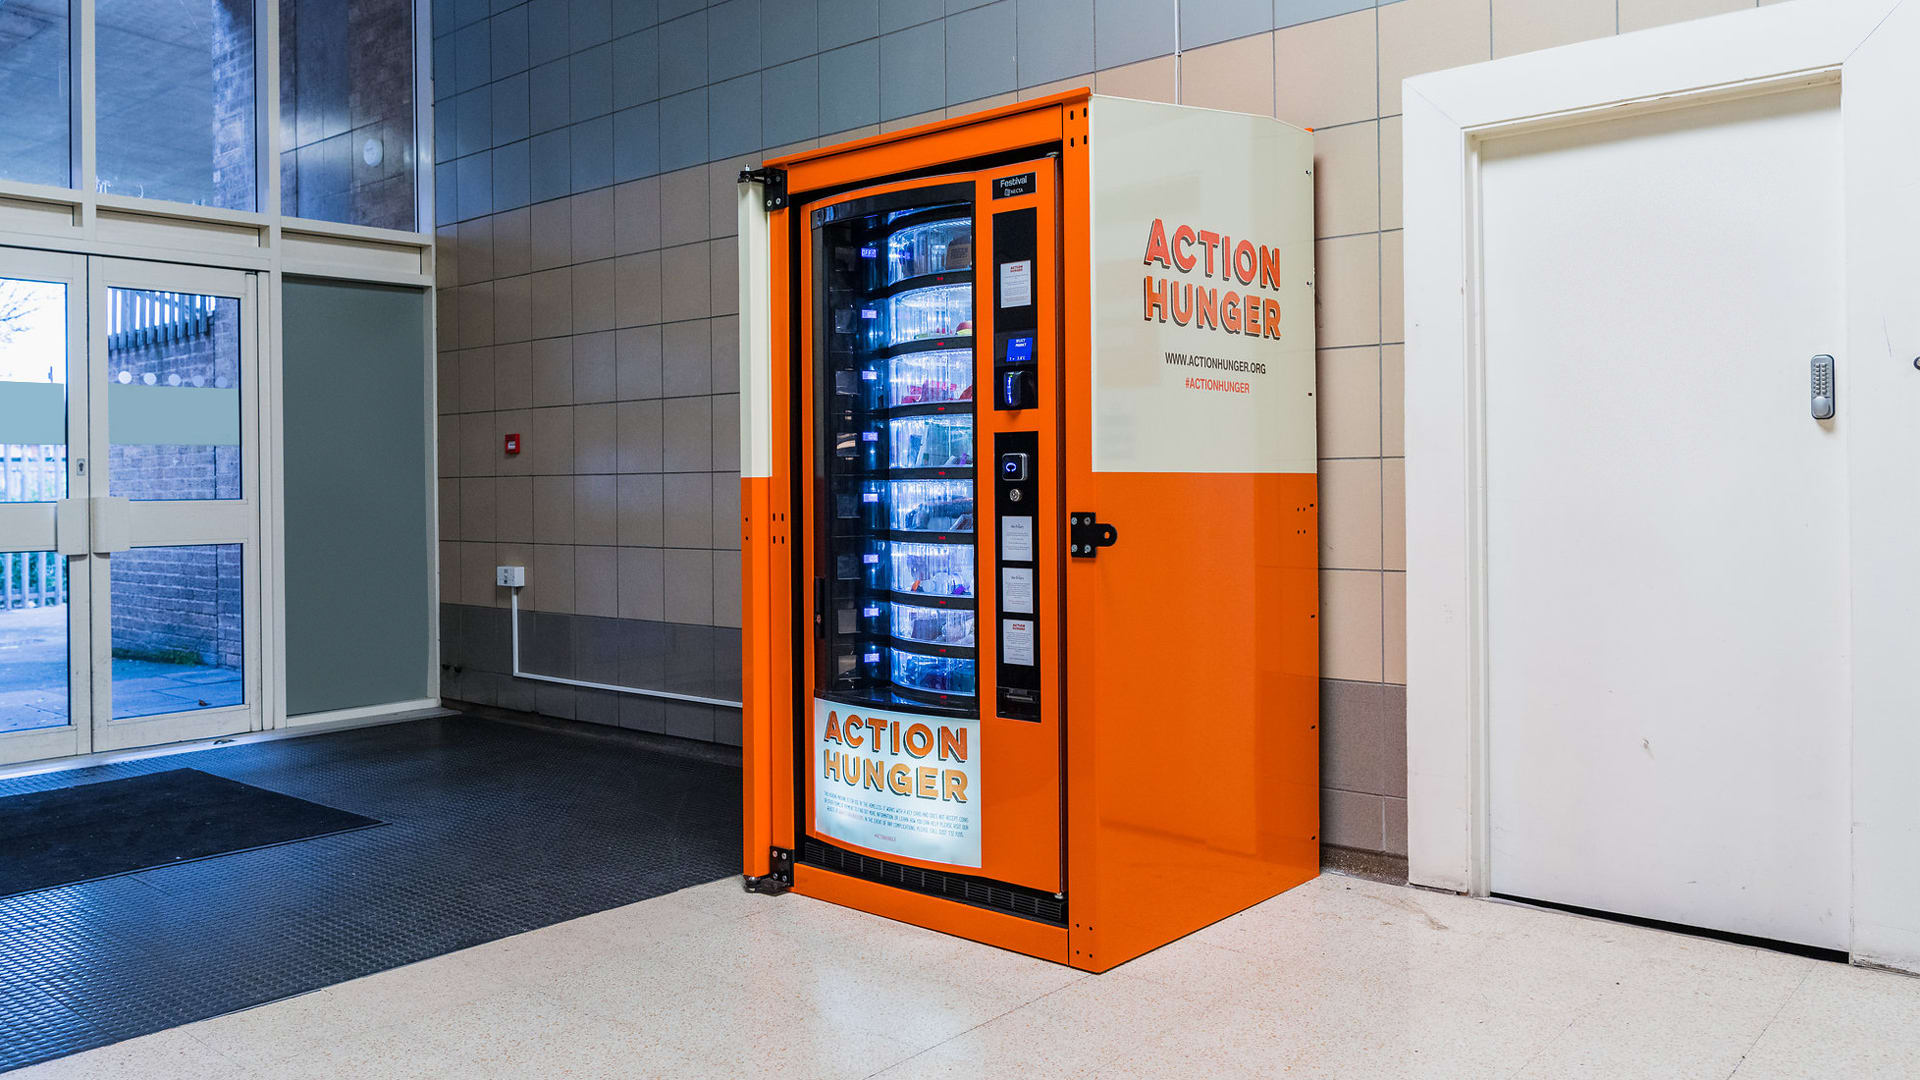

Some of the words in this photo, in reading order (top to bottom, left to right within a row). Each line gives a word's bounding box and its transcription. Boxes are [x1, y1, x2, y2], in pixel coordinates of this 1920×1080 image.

[1000, 175, 1027, 188] Festival
[1143, 218, 1281, 291] ACTION
[1144, 275, 1281, 341] HUNGER
[1164, 351, 1266, 375] WWW.ACTIONHUNGER.ORG
[1185, 377, 1250, 394] #ACTIONHUNGER
[824, 710, 968, 763] ACTION
[824, 748, 968, 804] HUNGER
